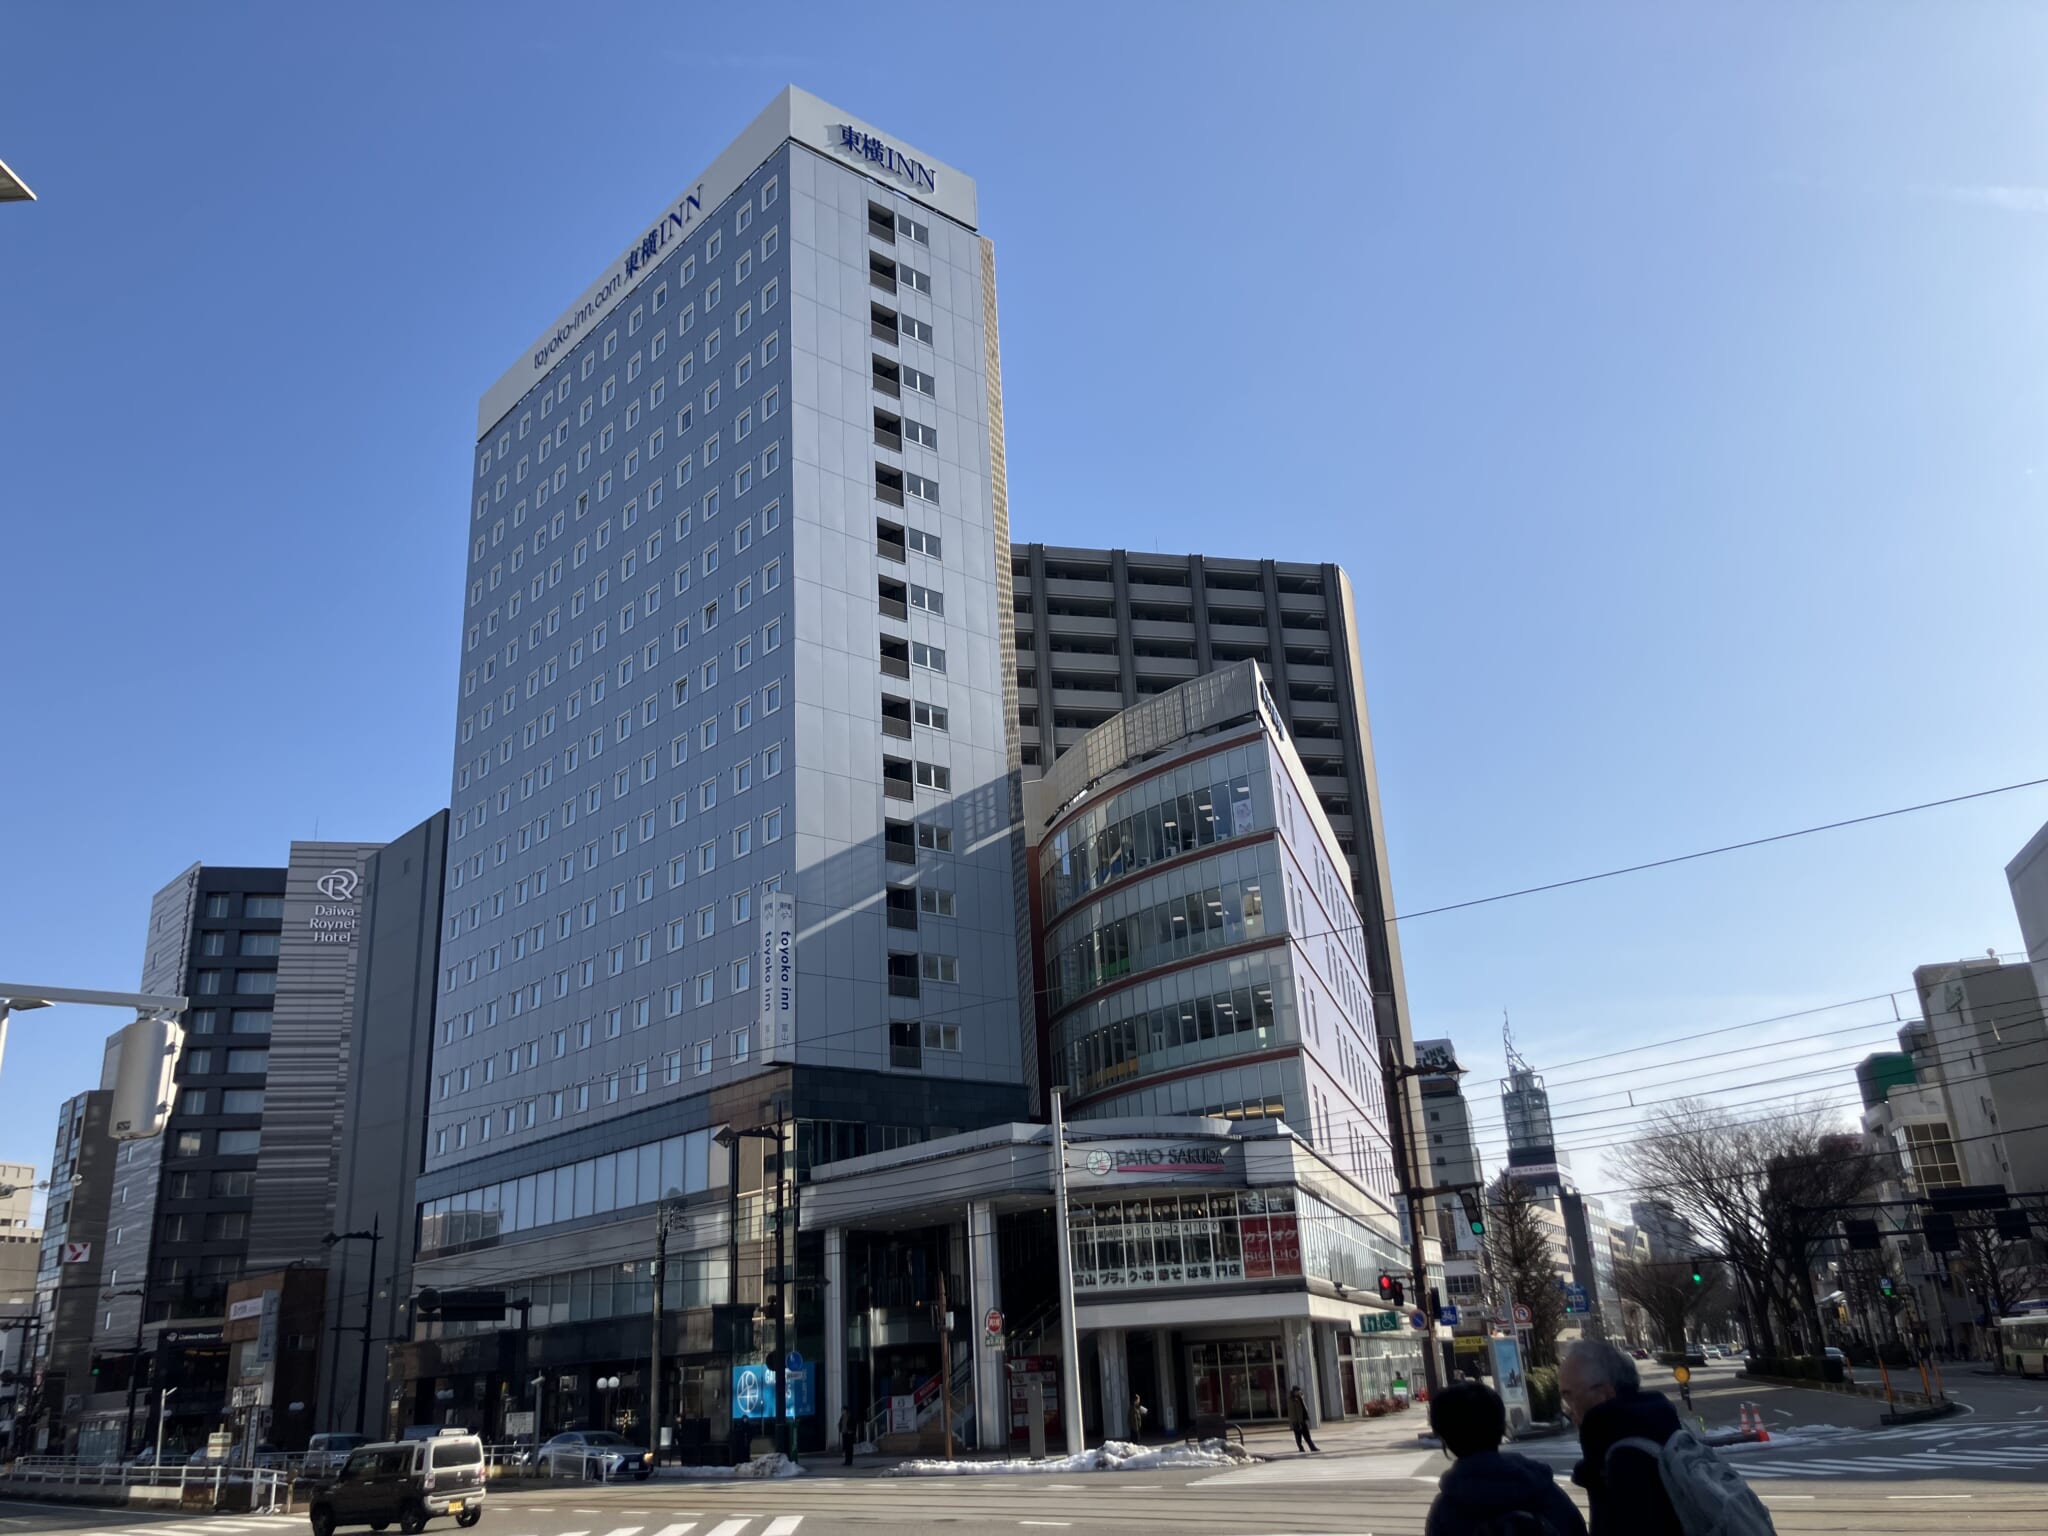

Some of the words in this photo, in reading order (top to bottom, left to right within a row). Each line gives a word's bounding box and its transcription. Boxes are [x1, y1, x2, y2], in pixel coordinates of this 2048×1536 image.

[839, 123, 937, 194] 東横INN
[533, 272, 622, 370] toyoko-inn.com
[623, 183, 705, 285] 東横INN
[314, 904, 355, 917] Daiwa
[310, 917, 357, 932] Roynet
[314, 931, 351, 943] Hotel
[763, 931, 773, 984] toyoko
[779, 929, 791, 982] toyoko
[781, 987, 791, 1011] inn
[1116, 1148, 1163, 1166] PATIO
[1168, 1147, 1225, 1165] SAKURA
[1244, 1228, 1298, 1242] カラオケ
